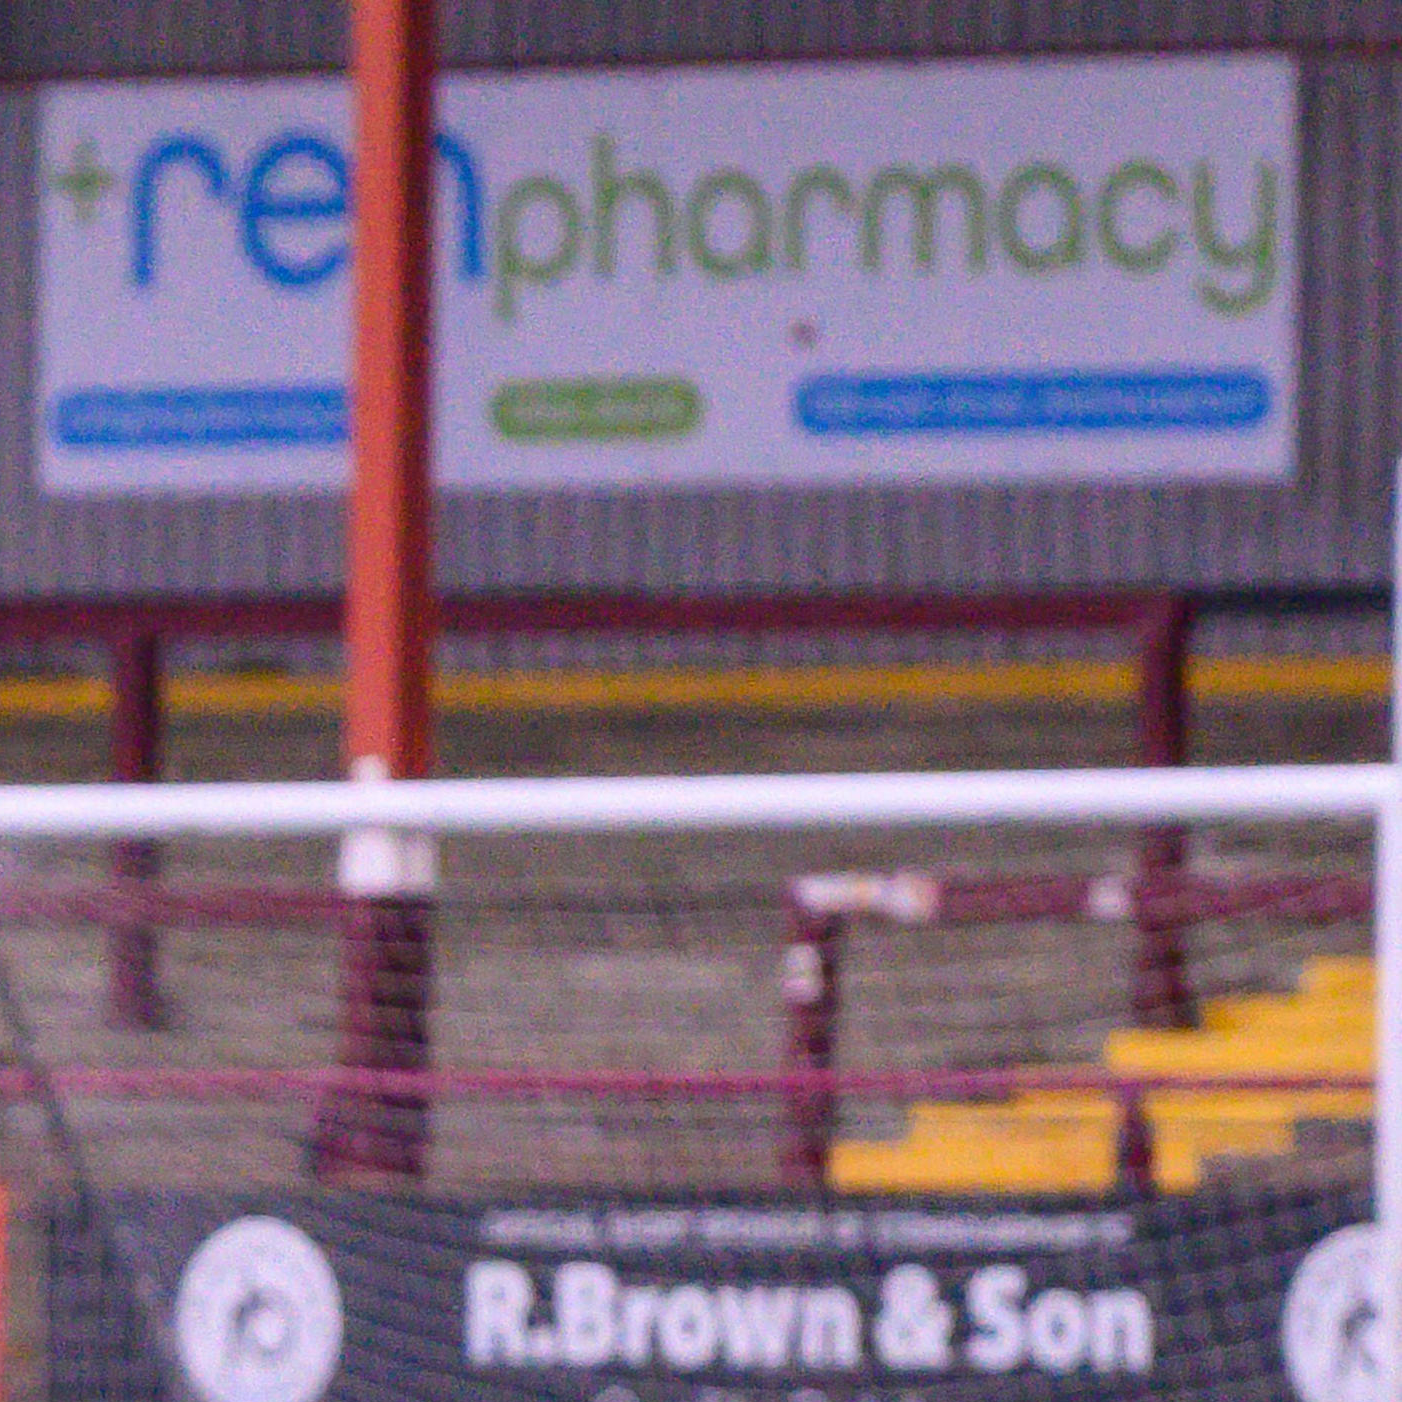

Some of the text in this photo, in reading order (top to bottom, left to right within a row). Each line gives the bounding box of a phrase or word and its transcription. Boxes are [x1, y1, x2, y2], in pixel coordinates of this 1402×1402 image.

[464, 1258, 1155, 1375] R.Brown & Son
